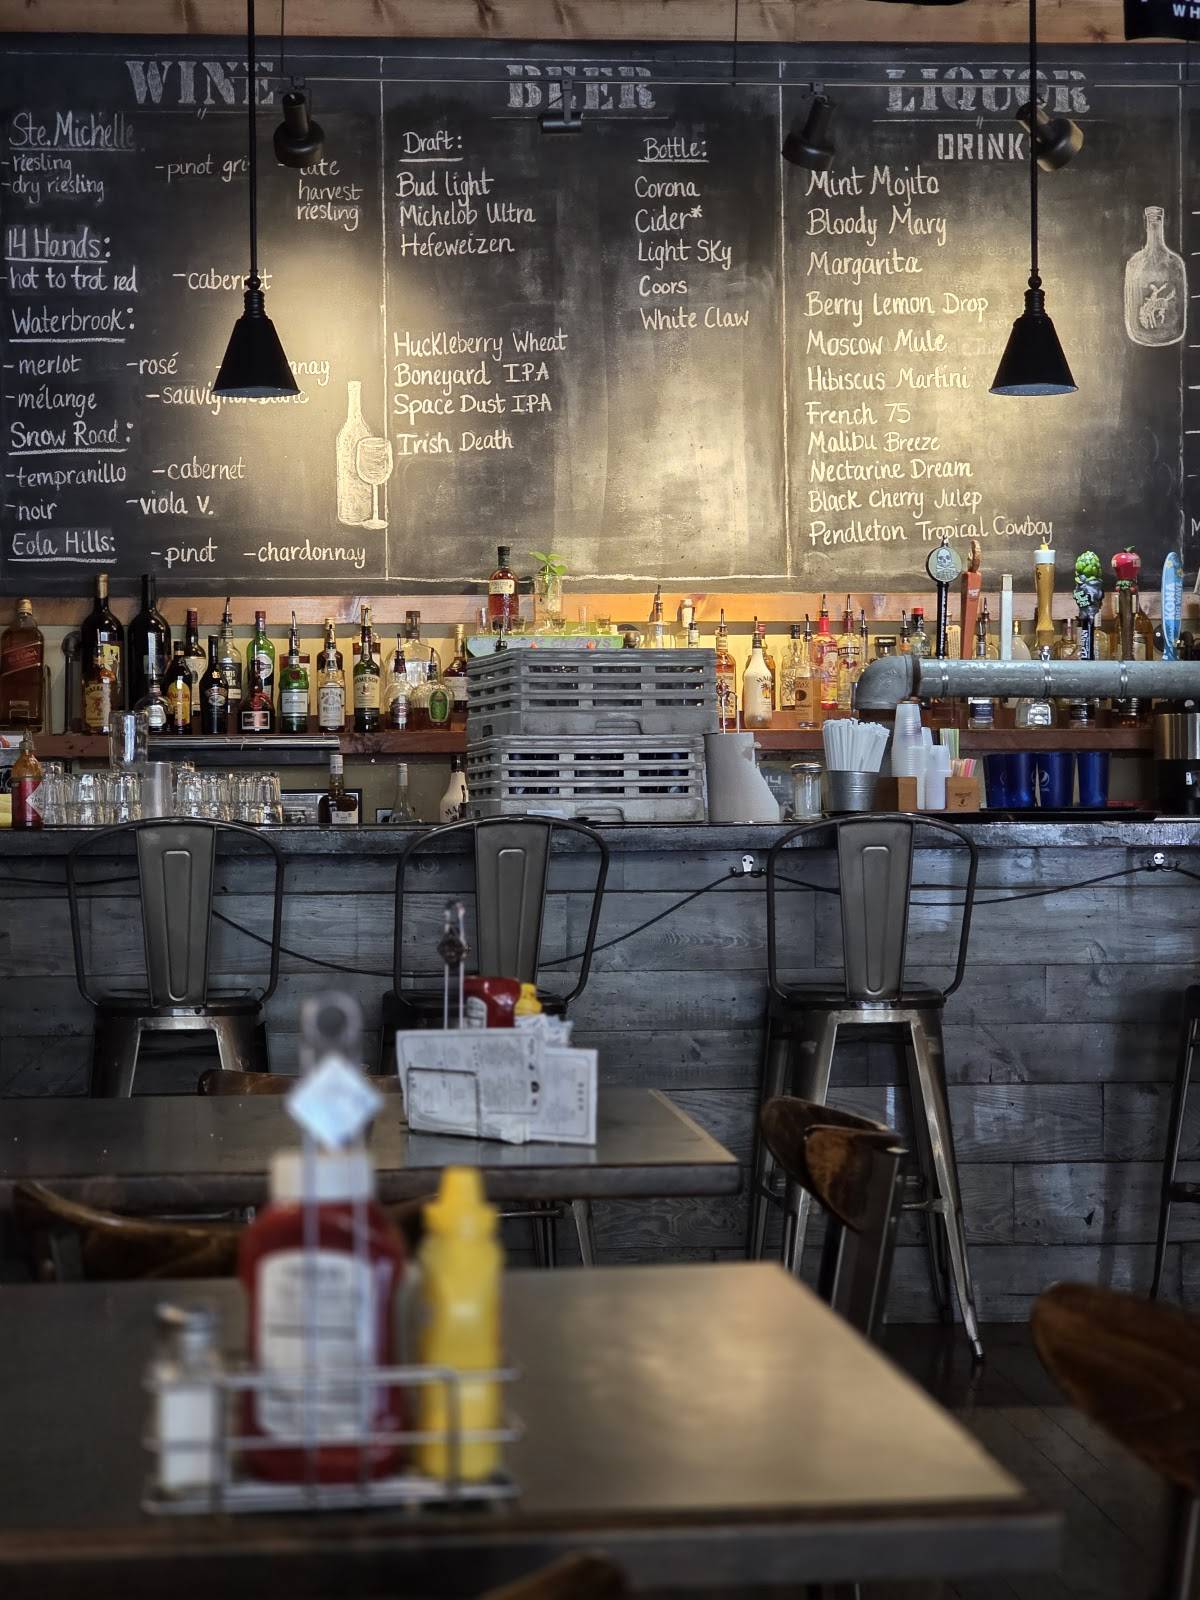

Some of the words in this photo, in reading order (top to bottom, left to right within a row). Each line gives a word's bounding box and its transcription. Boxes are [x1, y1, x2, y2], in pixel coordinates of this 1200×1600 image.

[125, 61, 274, 104] WINE
[506, 64, 656, 110] BEER
[886, 67, 1090, 113] LIQUOR
[53, 110, 134, 148] Michelle
[403, 131, 463, 153] Draft:
[644, 138, 707, 160] Bottle:
[937, 133, 1031, 160] DRINK
[222, 155, 250, 183] gri
[48, 177, 104, 203] riesling
[298, 179, 363, 201] harvest
[395, 171, 439, 197] Bud
[446, 167, 494, 206] light
[635, 176, 700, 198] Corona
[805, 168, 865, 197] Mint
[870, 165, 939, 205] Mojito
[297, 202, 359, 231] riesling
[400, 204, 478, 227] Michelob
[487, 202, 536, 223] Ultra
[806, 208, 877, 246] Bloody
[889, 205, 947, 246] Mary
[8, 228, 26, 258] 14
[34, 226, 111, 258] Hands:
[401, 233, 515, 256] Hefeweizen
[638, 240, 692, 271] Light
[47, 267, 66, 290] to
[72, 265, 105, 291] trot
[113, 265, 138, 292] red
[807, 252, 922, 285] Margarita
[639, 276, 687, 297] Coors
[640, 306, 698, 330] White
[704, 306, 750, 328] Claw
[804, 291, 862, 327] Berry
[873, 293, 934, 316] Lemon
[943, 292, 988, 322] Drop
[513, 328, 568, 352] Wheat
[806, 330, 882, 355] Moscow
[894, 329, 947, 352] Mule
[394, 361, 491, 395] Boneyard
[808, 366, 885, 392] Hibiscus
[896, 364, 970, 390] Martini
[394, 394, 455, 425] Space
[460, 393, 506, 413] Dust
[805, 401, 877, 425] French
[886, 403, 911, 424] 75
[10, 422, 66, 448] Snow
[396, 430, 451, 455] Irish
[459, 430, 514, 452] Death
[808, 431, 877, 455] Malibu
[884, 432, 940, 451] Breeze
[810, 461, 904, 482] Nectarine
[911, 458, 973, 478] Dream
[808, 490, 860, 513] Black
[869, 490, 924, 518] Cherry
[934, 488, 982, 514] Julep
[810, 521, 907, 545] Pendleton
[916, 516, 988, 541] Tropical
[993, 516, 1053, 545] Cowboy
[12, 533, 57, 556] Eola
